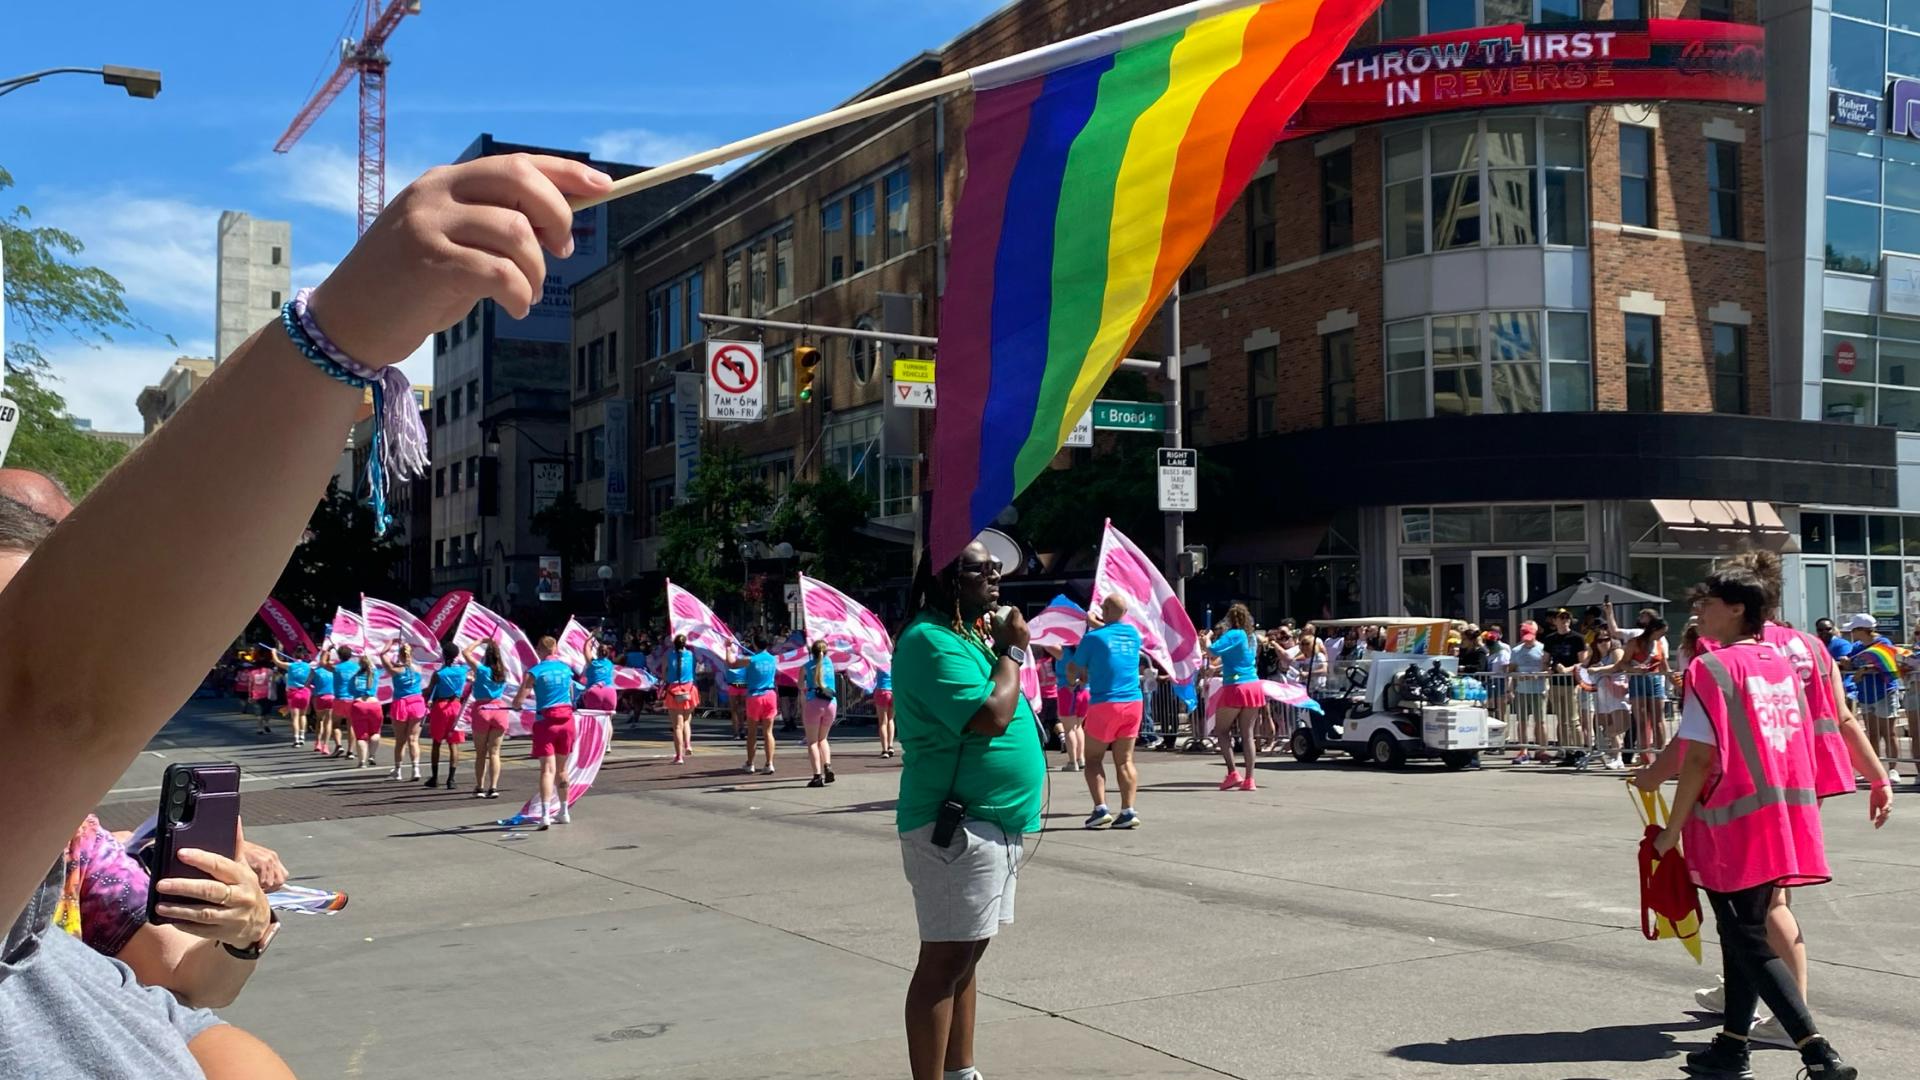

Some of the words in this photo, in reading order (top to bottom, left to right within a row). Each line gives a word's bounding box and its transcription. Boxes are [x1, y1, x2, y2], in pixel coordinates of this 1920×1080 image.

[1336, 41, 1470, 86] THROW
[1479, 32, 1616, 64] THIRST
[1386, 78, 1421, 107] IN
[1434, 62, 1615, 100] REVERSE
[1837, 97, 1868, 112] Robert
[1838, 107, 1865, 122] Weiler
[1109, 408, 1146, 424] Broad
[1166, 451, 1188, 459] RIGHT
[1167, 458, 1188, 466] LANE
